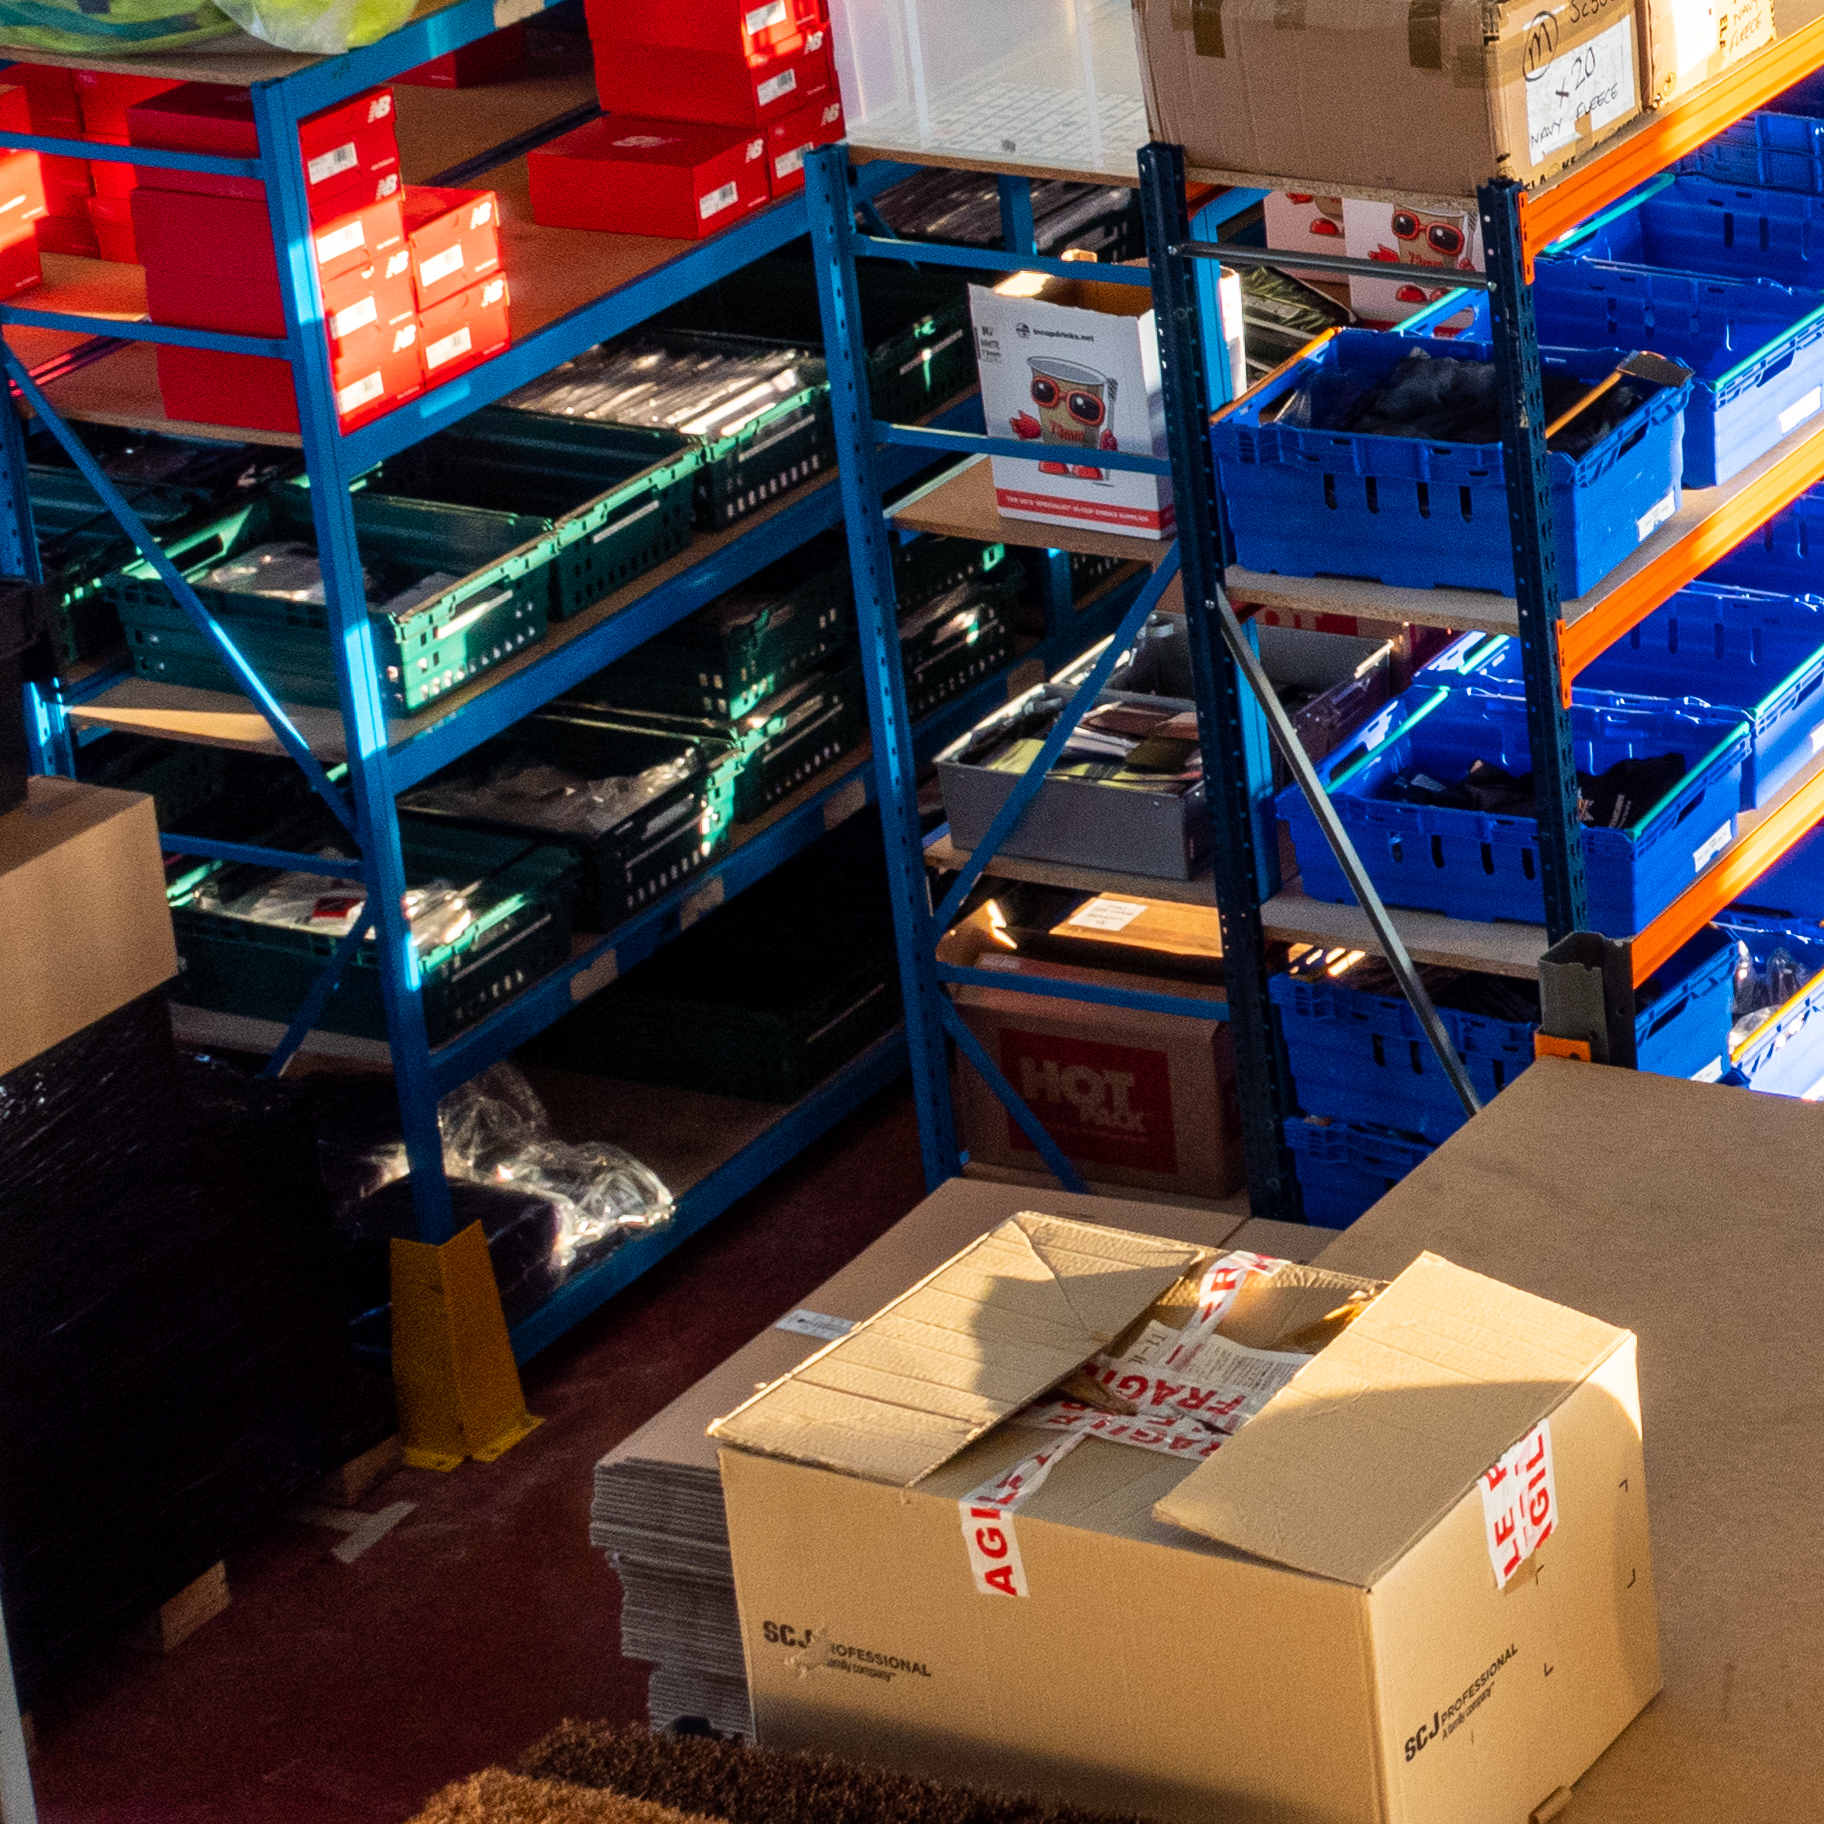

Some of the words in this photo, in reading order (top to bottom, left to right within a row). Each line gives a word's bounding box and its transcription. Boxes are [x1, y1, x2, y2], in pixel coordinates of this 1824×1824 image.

[1729, 11, 1763, 54] FLEECE
[367, 94, 392, 124] NB
[1530, 117, 1563, 151] NAVY
[1575, 83, 1619, 122] FLEECE
[745, 138, 765, 164] NB
[1033, 328, 1095, 344] incupdrinks.net
[1050, 420, 1085, 443] 73mm
[1020, 1056, 1136, 1113] HOT
[763, 1619, 812, 1649] SCJ
[830, 1643, 932, 1678] OFESSIONAL
[1404, 1710, 1440, 1763] SCJ
[1440, 1642, 1519, 1727] PROFESSIONAL
